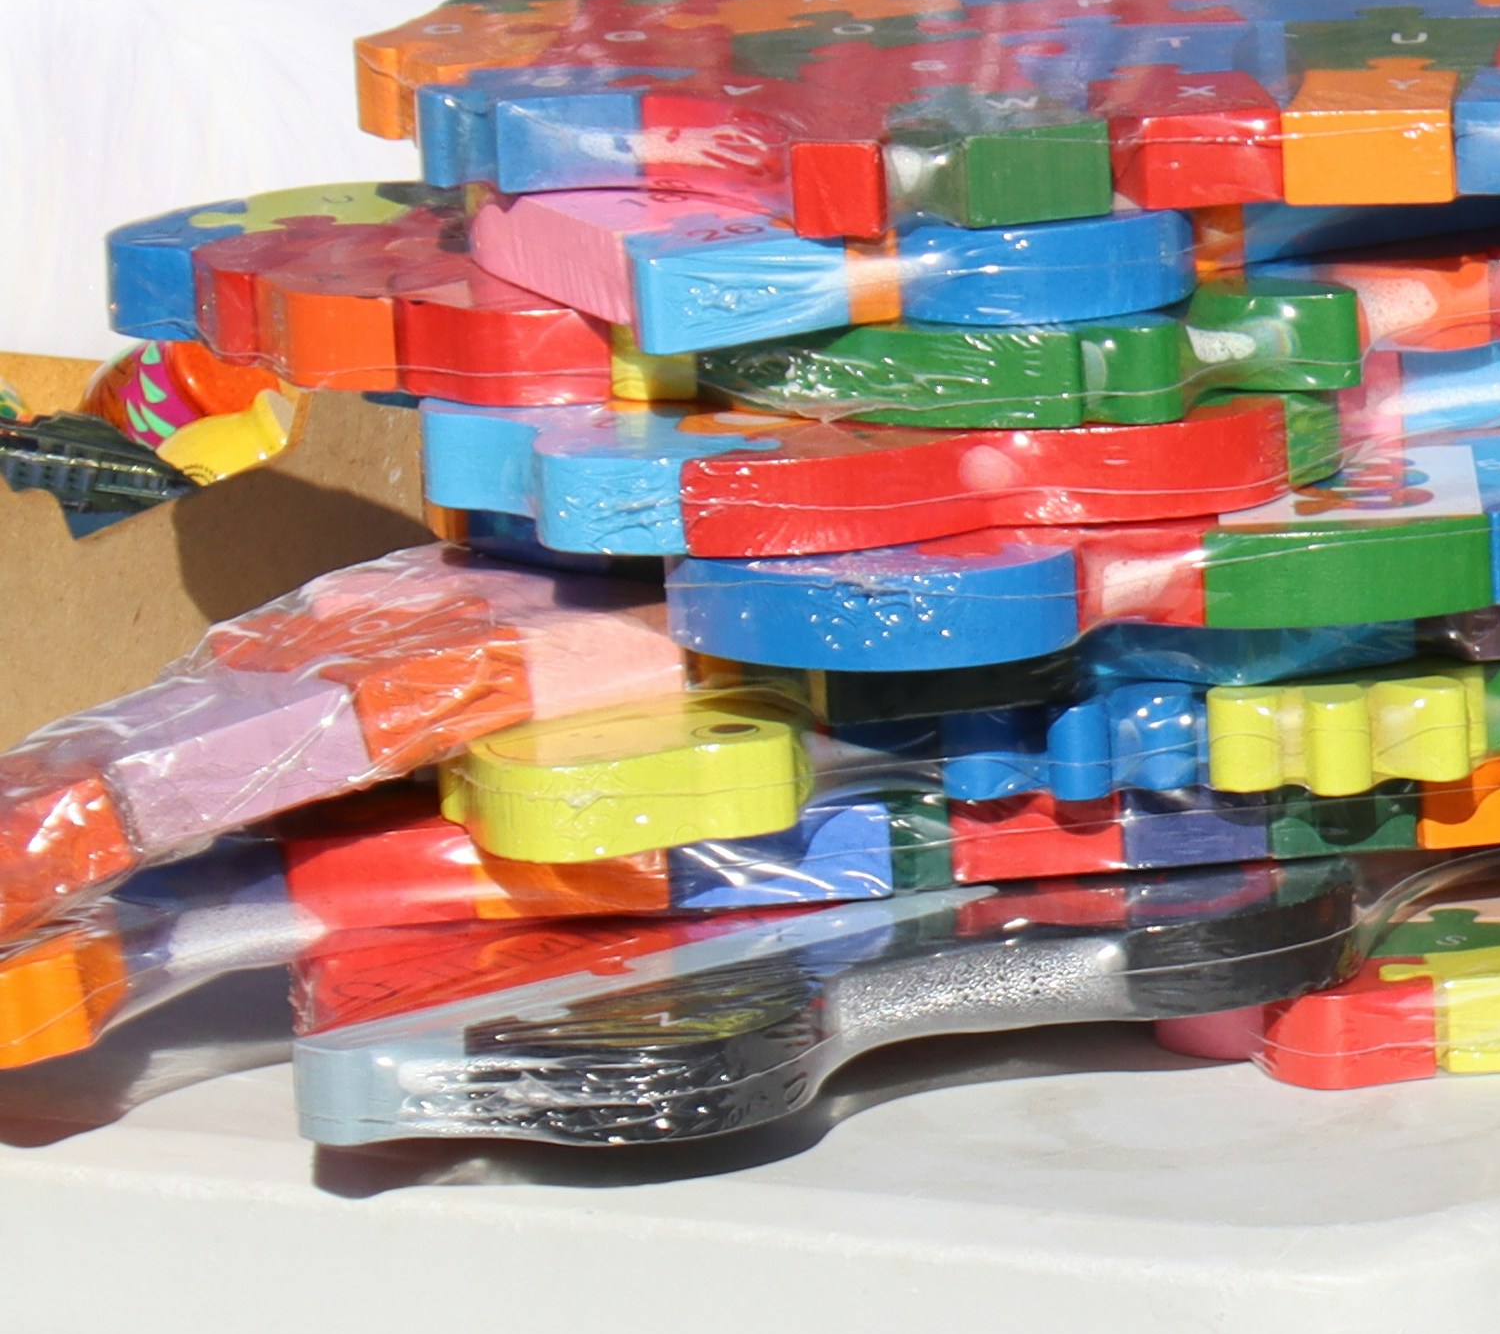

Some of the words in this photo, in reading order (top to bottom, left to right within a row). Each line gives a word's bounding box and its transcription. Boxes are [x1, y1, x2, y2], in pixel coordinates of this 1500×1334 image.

[1156, 35, 1191, 48] T
[1390, 31, 1428, 45] U
[985, 95, 1040, 110] W
[1176, 84, 1217, 98] X
[1387, 78, 1420, 90] Y
[685, 222, 764, 243] 26
